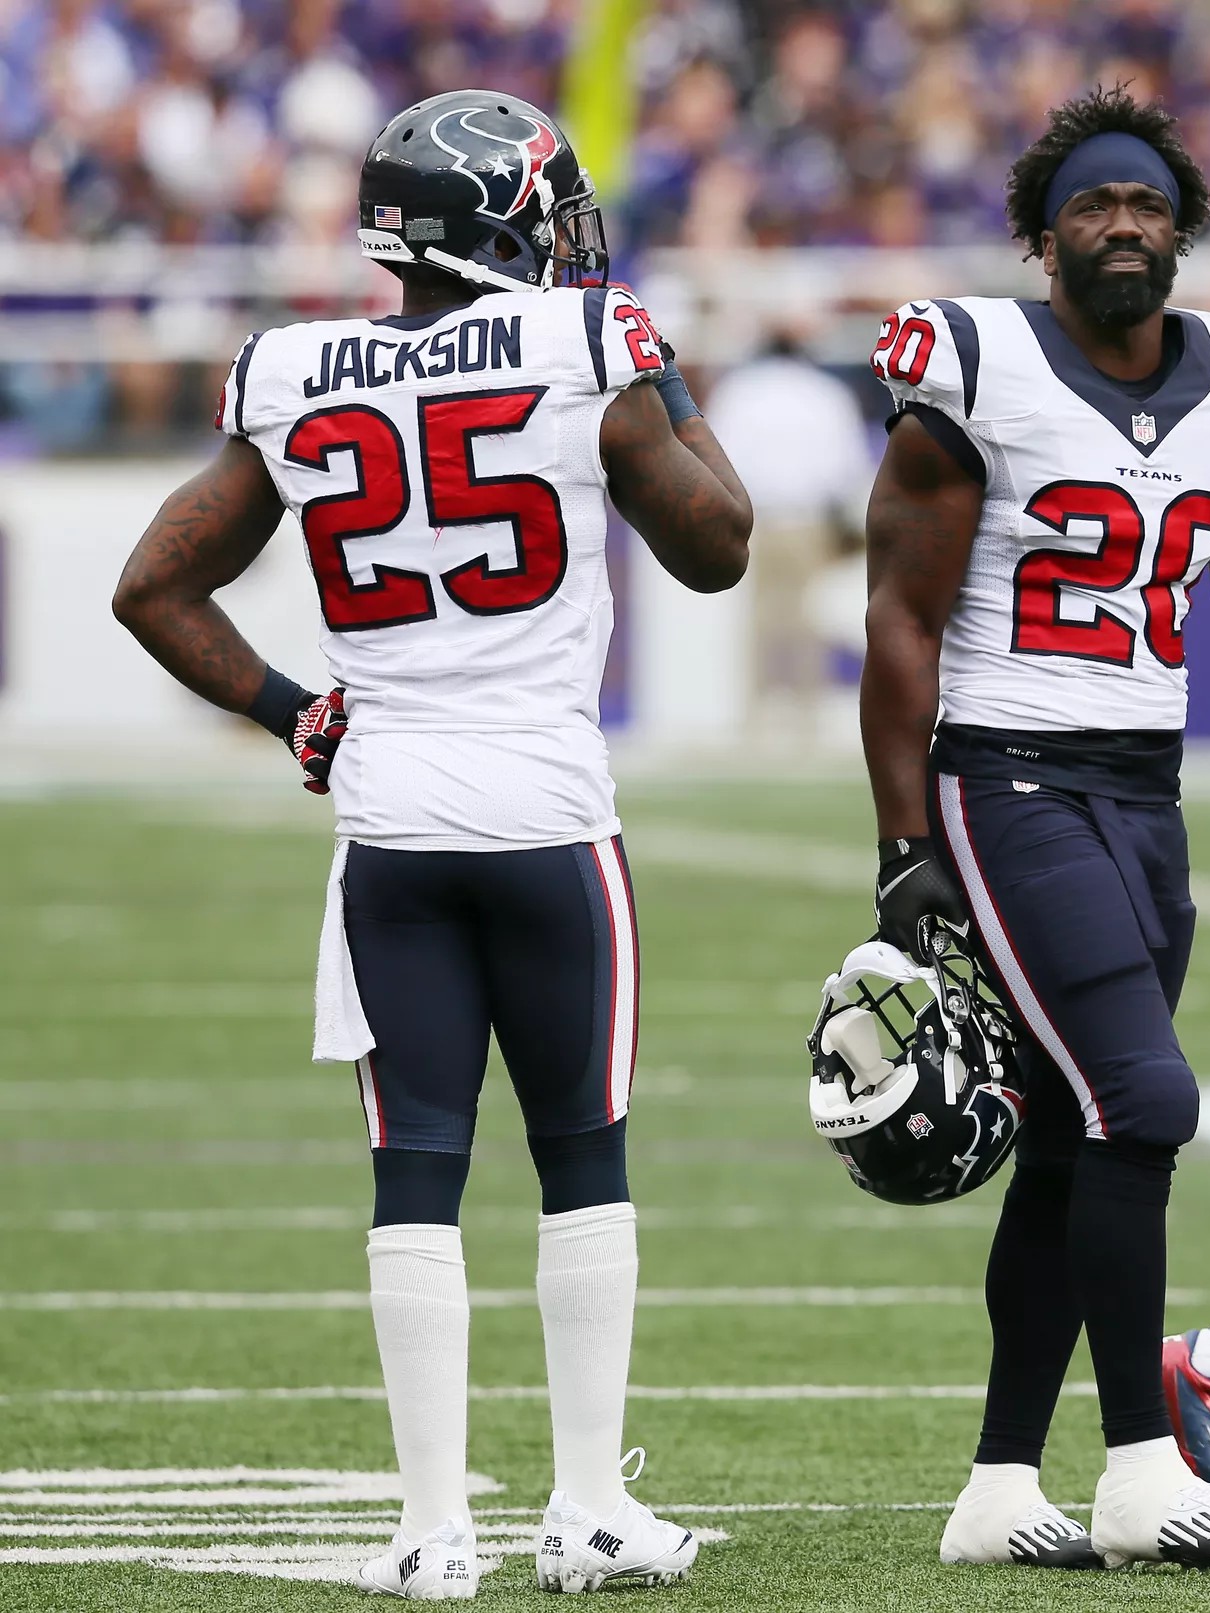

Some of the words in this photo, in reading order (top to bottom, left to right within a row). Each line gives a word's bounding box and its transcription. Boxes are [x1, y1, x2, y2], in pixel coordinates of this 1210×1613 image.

[362, 241, 402, 251] EXANS
[869, 312, 936, 386] 20
[303, 316, 522, 398] JACKSON
[1136, 426, 1153, 439] NFL
[1115, 467, 1182, 482] TEXANS
[284, 386, 570, 633] 25
[1006, 747, 1040, 758] DRI-FIT
[816, 1115, 870, 1129] TEXANS
[910, 1115, 926, 1130] NFL
[544, 1535, 563, 1548] 25
[587, 1528, 624, 1559] NIKE
[540, 1547, 564, 1557] BFAM
[399, 1547, 421, 1586] NIKE
[446, 1560, 466, 1571] 25
[443, 1572, 470, 1580] BFAM
